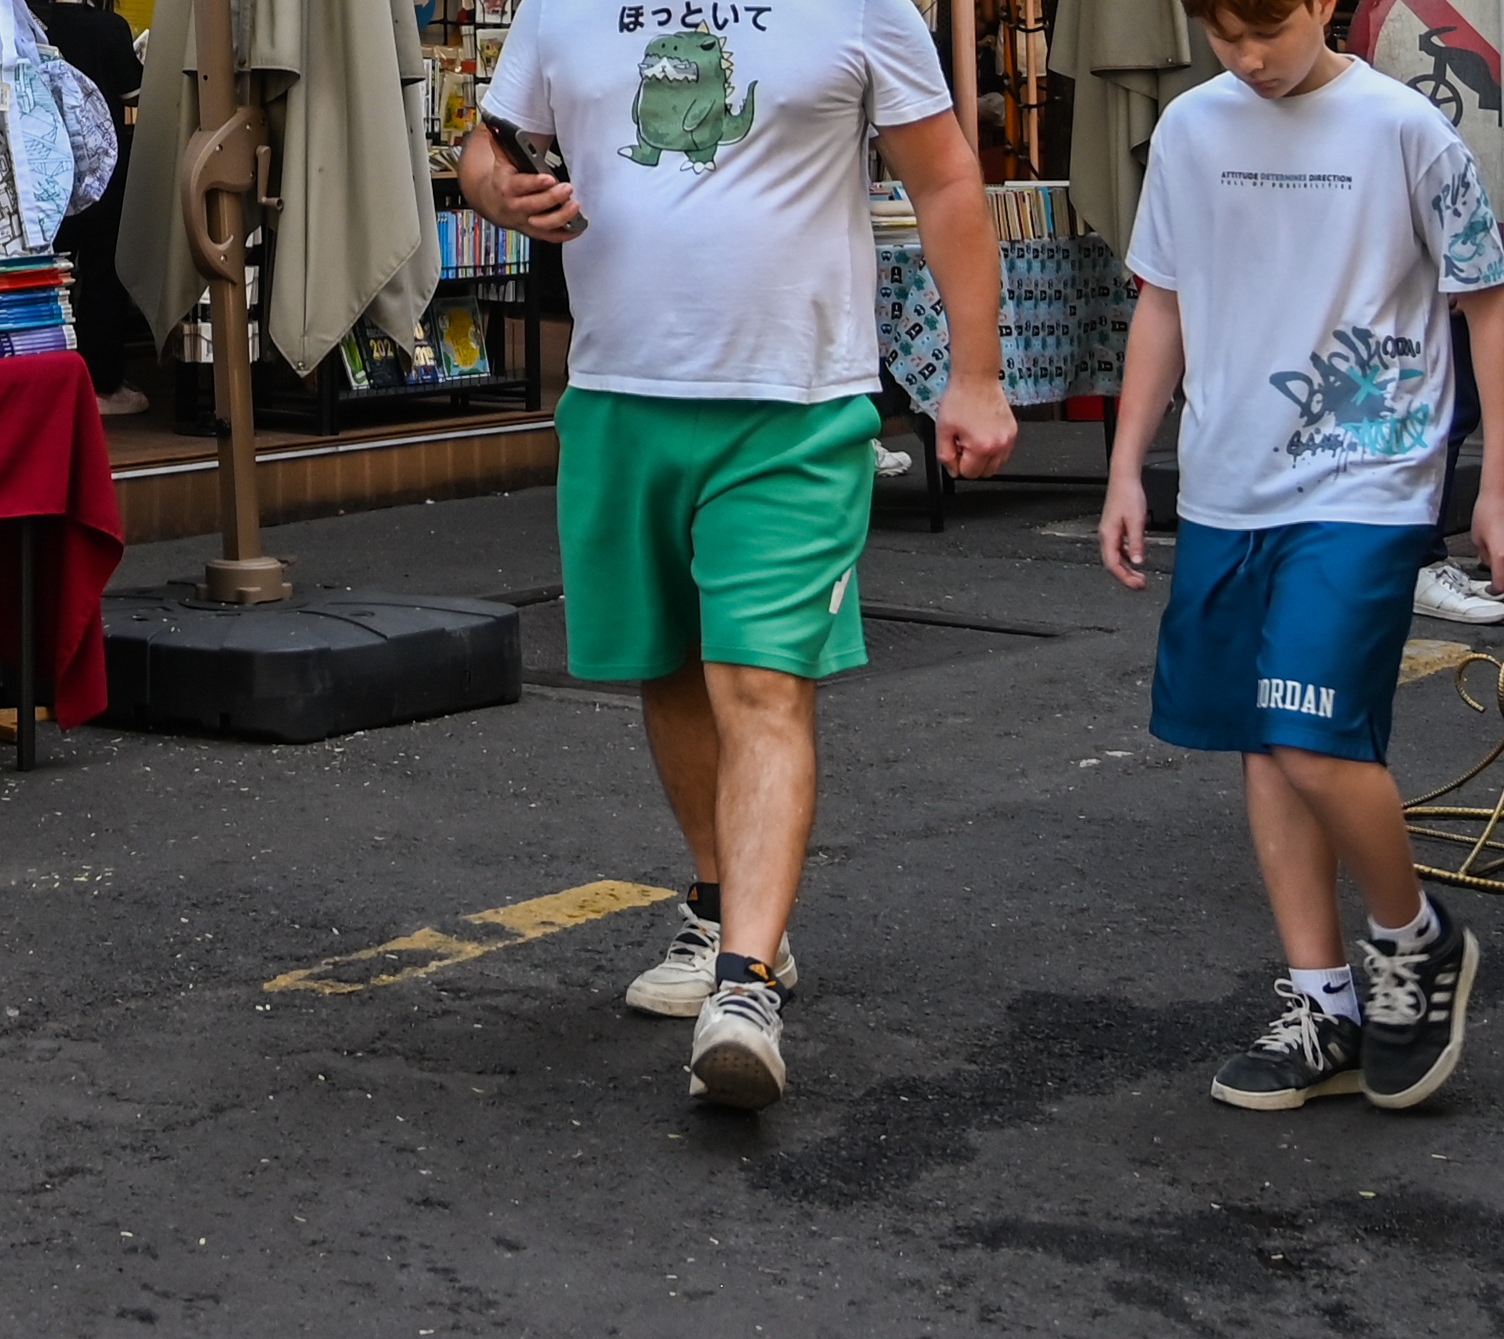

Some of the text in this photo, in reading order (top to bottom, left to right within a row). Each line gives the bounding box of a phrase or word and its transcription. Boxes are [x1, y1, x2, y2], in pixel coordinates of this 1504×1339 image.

[617, 3, 775, 34] ほっといて
[1221, 171, 1352, 183] ATTITUDE DETERMINES DIRECTION
